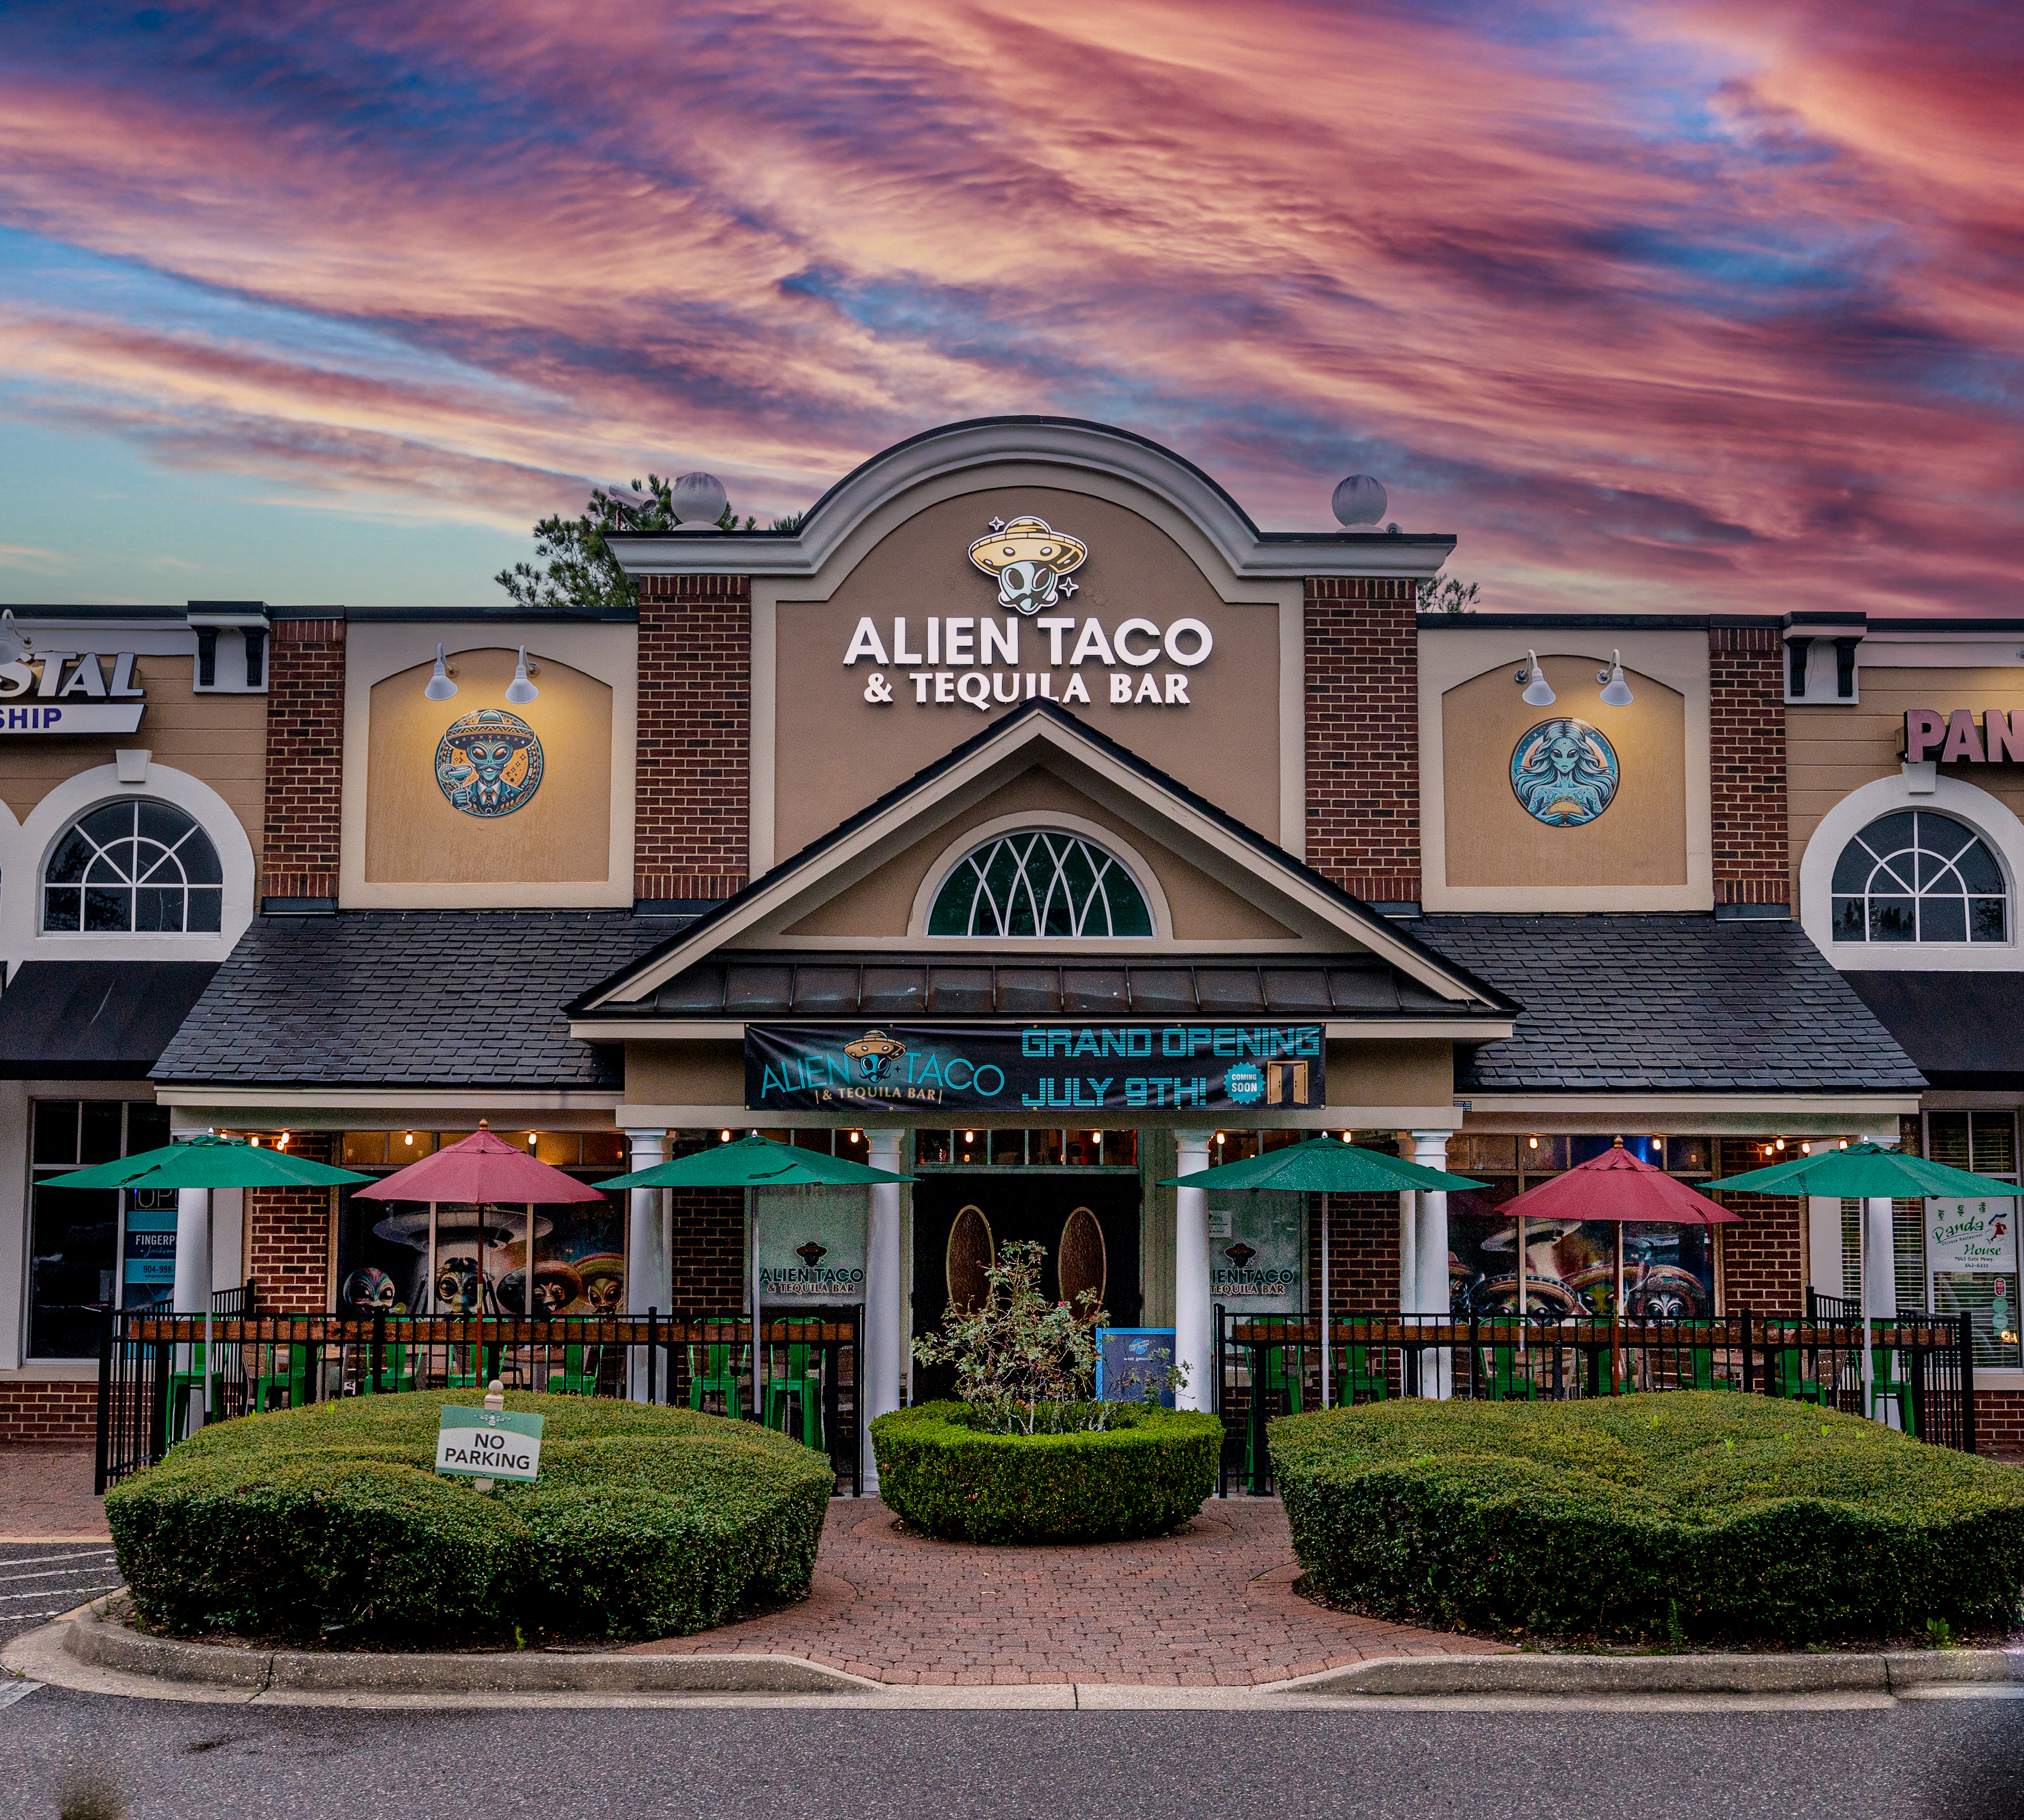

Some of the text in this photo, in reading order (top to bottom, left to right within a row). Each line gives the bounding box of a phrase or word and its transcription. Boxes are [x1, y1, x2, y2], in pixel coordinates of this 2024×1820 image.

[843, 616, 1213, 667] ALIEN TACO
[863, 672, 1191, 712] & TEQUILA BAR
[0, 708, 62, 729] HIP
[1022, 1027, 1320, 1057] GRAND OPENING
[761, 1052, 1005, 1099] ALIEN TACO
[837, 1086, 902, 1099] TEQUILA
[907, 1087, 936, 1101] BAR
[1022, 1077, 1206, 1106] JULY 9TH!
[1231, 1082, 1258, 1093] SOON
[1932, 1216, 1984, 1244] Panda
[1959, 1233, 1983, 1241] Restaurant
[136, 1235, 177, 1245] FINGERP
[1964, 1243, 2002, 1255] House
[759, 1267, 865, 1283] ALIEN TACO
[1209, 1268, 1294, 1285] IEN TACO
[767, 1283, 855, 1294] & TEQUILA BAR
[1210, 1284, 1285, 1296] TEQUILA BAR
[474, 1433, 505, 1450] NO
[444, 1447, 530, 1470] PARKING
